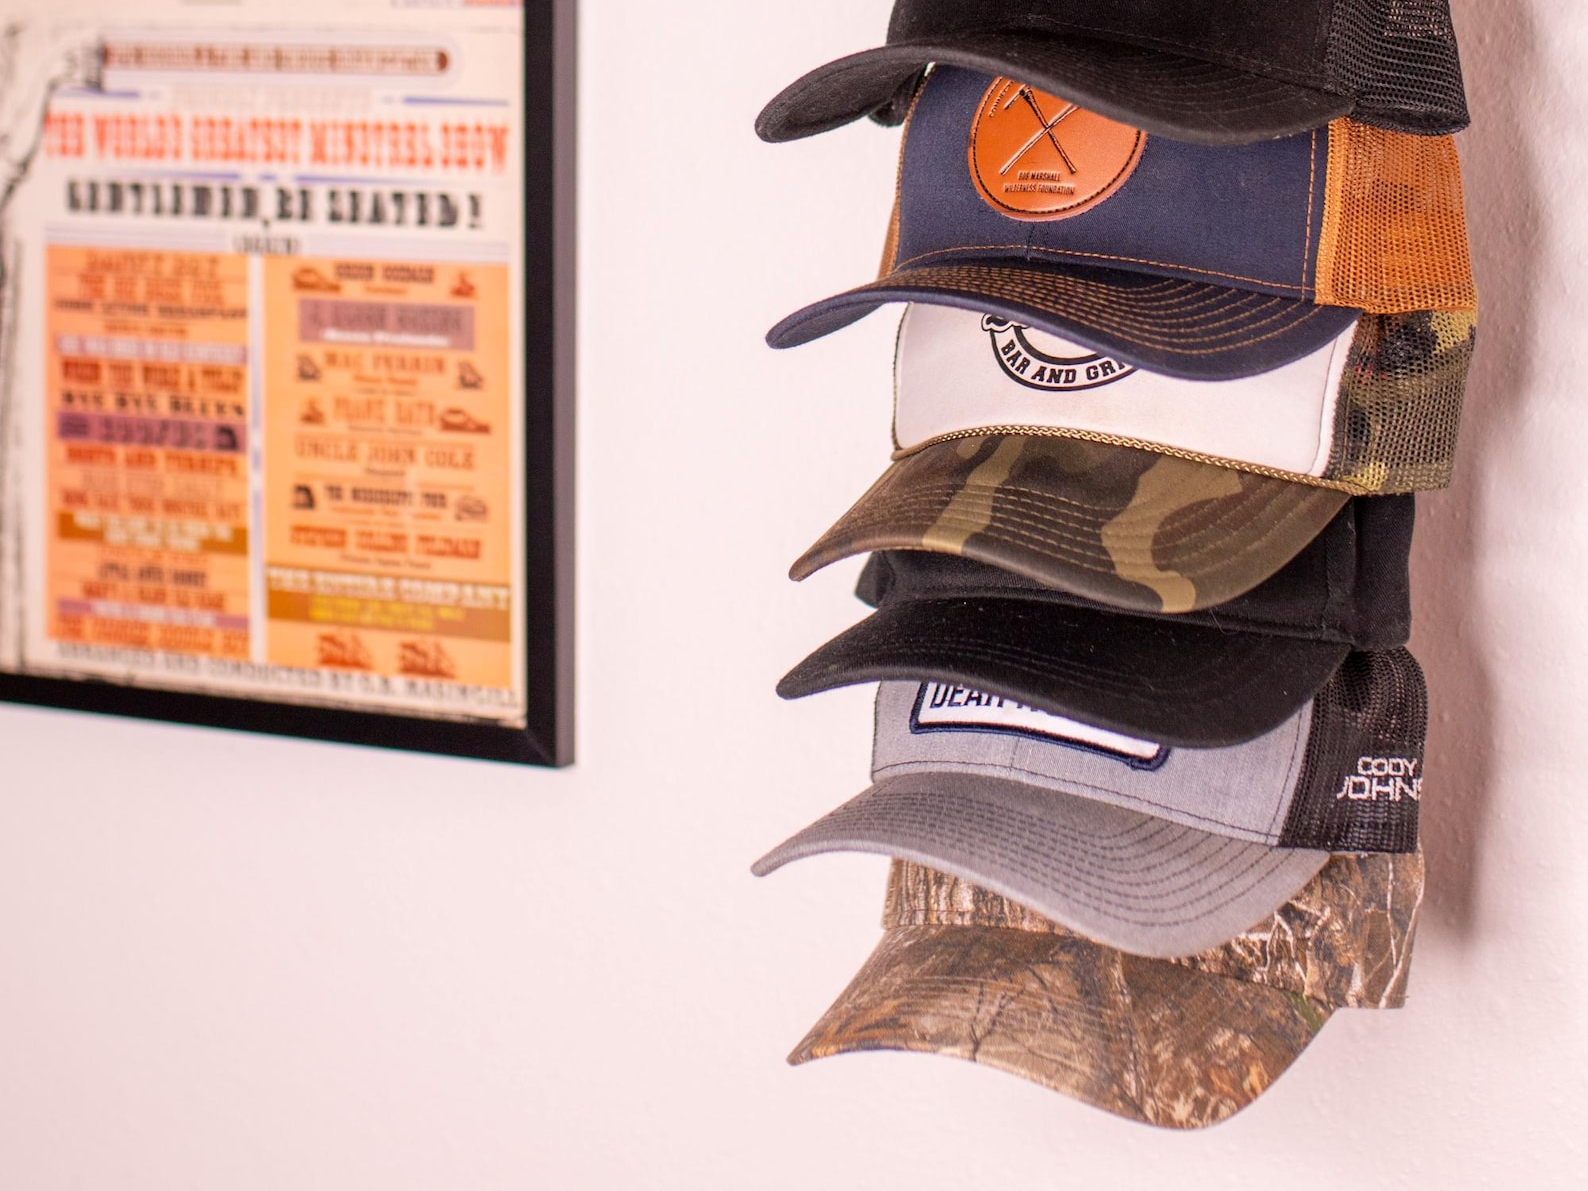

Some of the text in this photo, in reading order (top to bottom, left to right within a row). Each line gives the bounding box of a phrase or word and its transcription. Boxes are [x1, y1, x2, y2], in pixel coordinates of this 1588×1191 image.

[1001, 339, 1030, 375] BAR
[1031, 366, 1076, 384] AND
[1357, 756, 1418, 777] CODY
